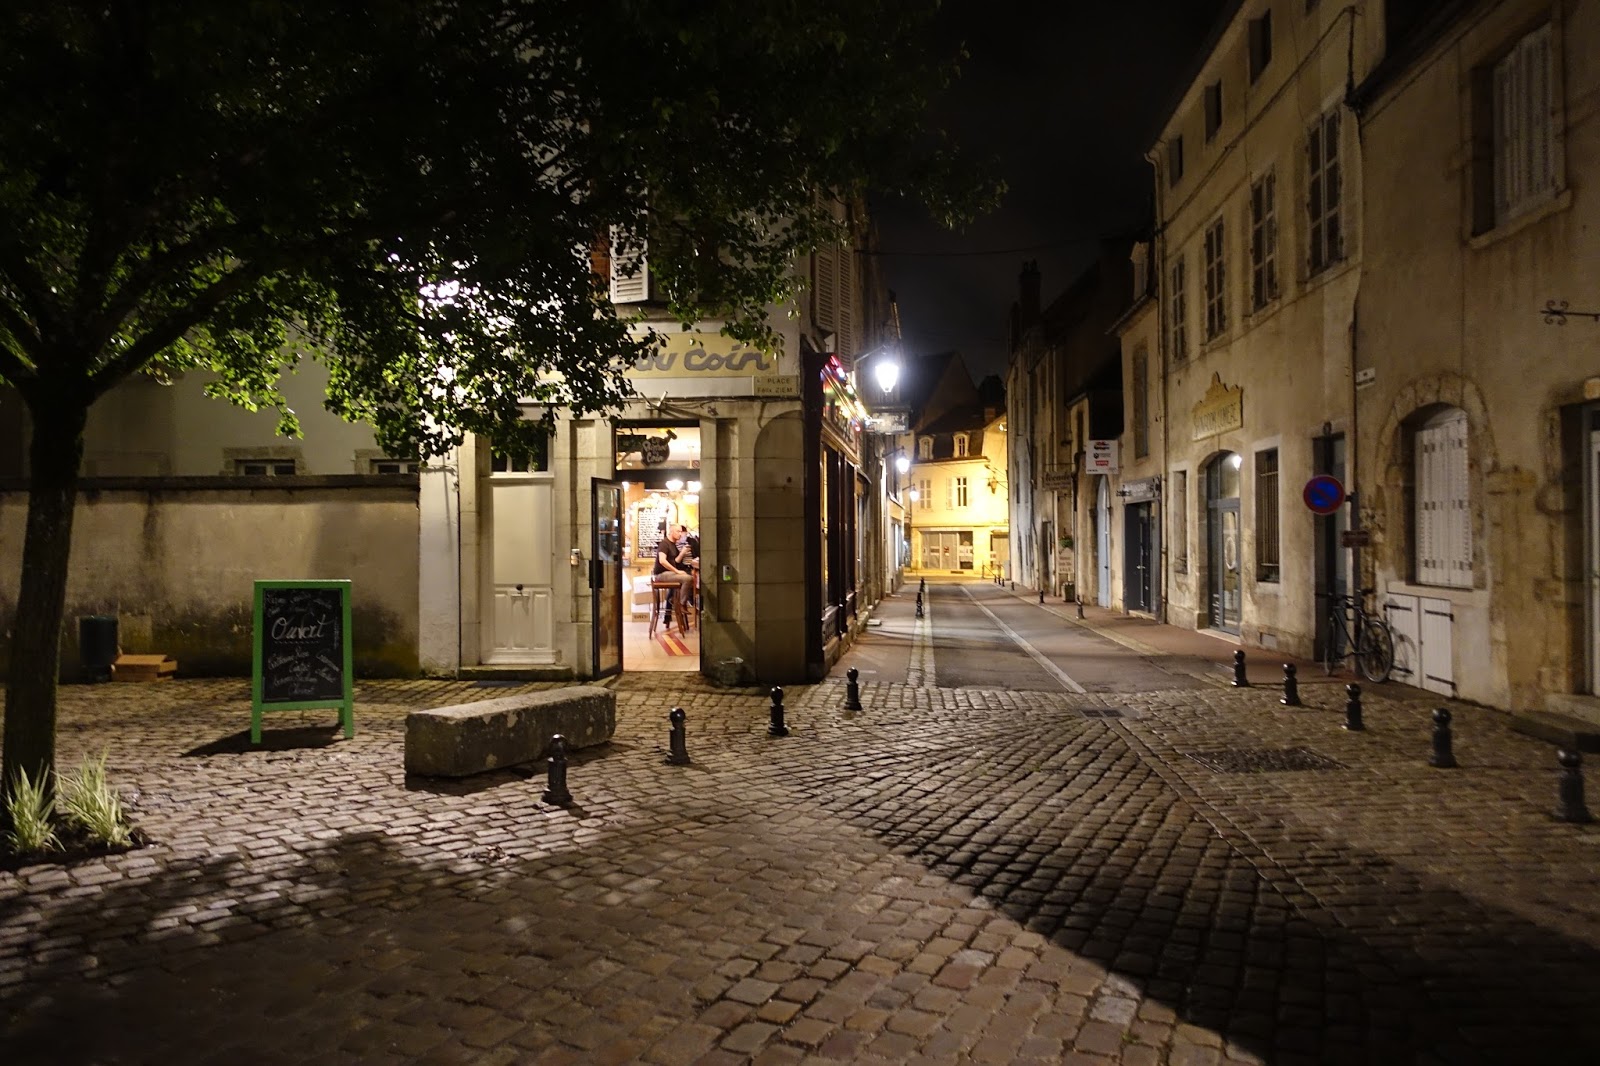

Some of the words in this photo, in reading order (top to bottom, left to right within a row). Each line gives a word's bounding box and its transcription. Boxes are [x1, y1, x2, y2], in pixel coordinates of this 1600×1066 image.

[683, 344, 770, 371] Coin
[767, 377, 791, 385] PLACE
[775, 386, 793, 394] ZIEM
[271, 613, 332, 640] Ouvert
